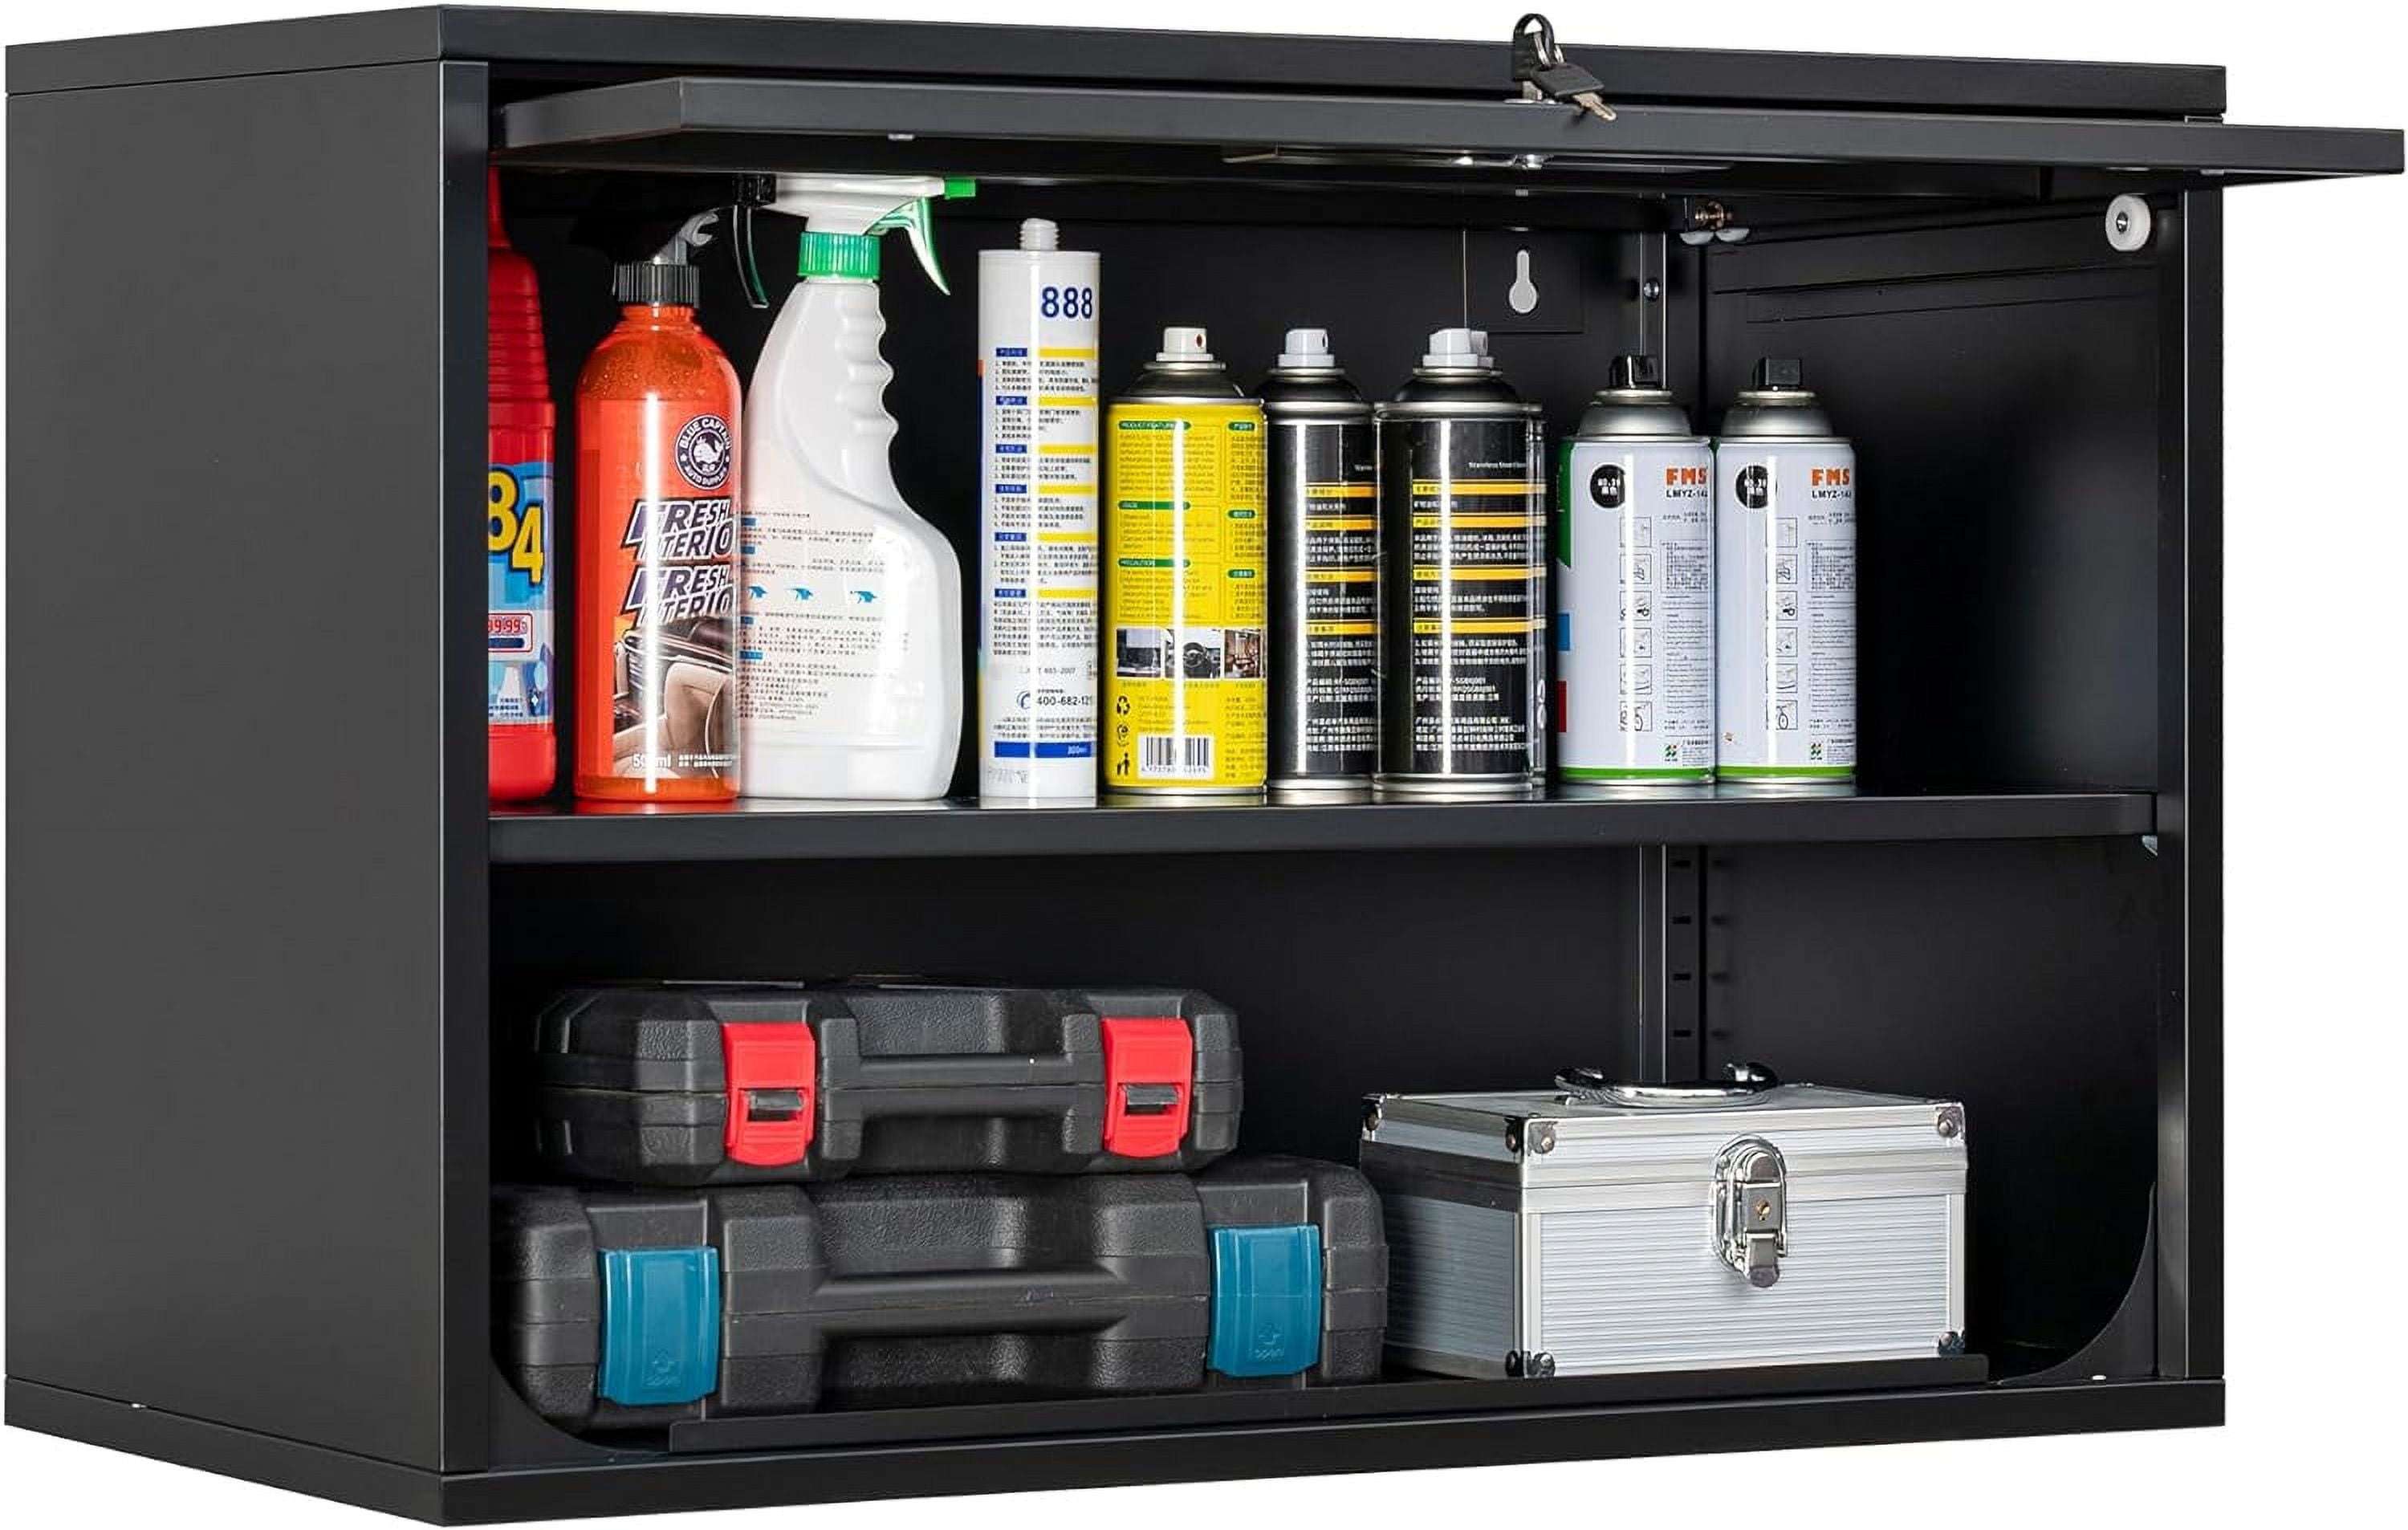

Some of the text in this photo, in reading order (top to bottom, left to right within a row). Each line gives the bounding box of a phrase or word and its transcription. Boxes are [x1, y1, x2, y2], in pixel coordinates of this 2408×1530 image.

[1041, 287, 1092, 319] 888
[679, 421, 702, 449] BLUE
[1666, 467, 1707, 486] FMS
[1811, 468, 1850, 486] FMS
[488, 469, 544, 584] 84
[633, 753, 671, 768] 5ml
